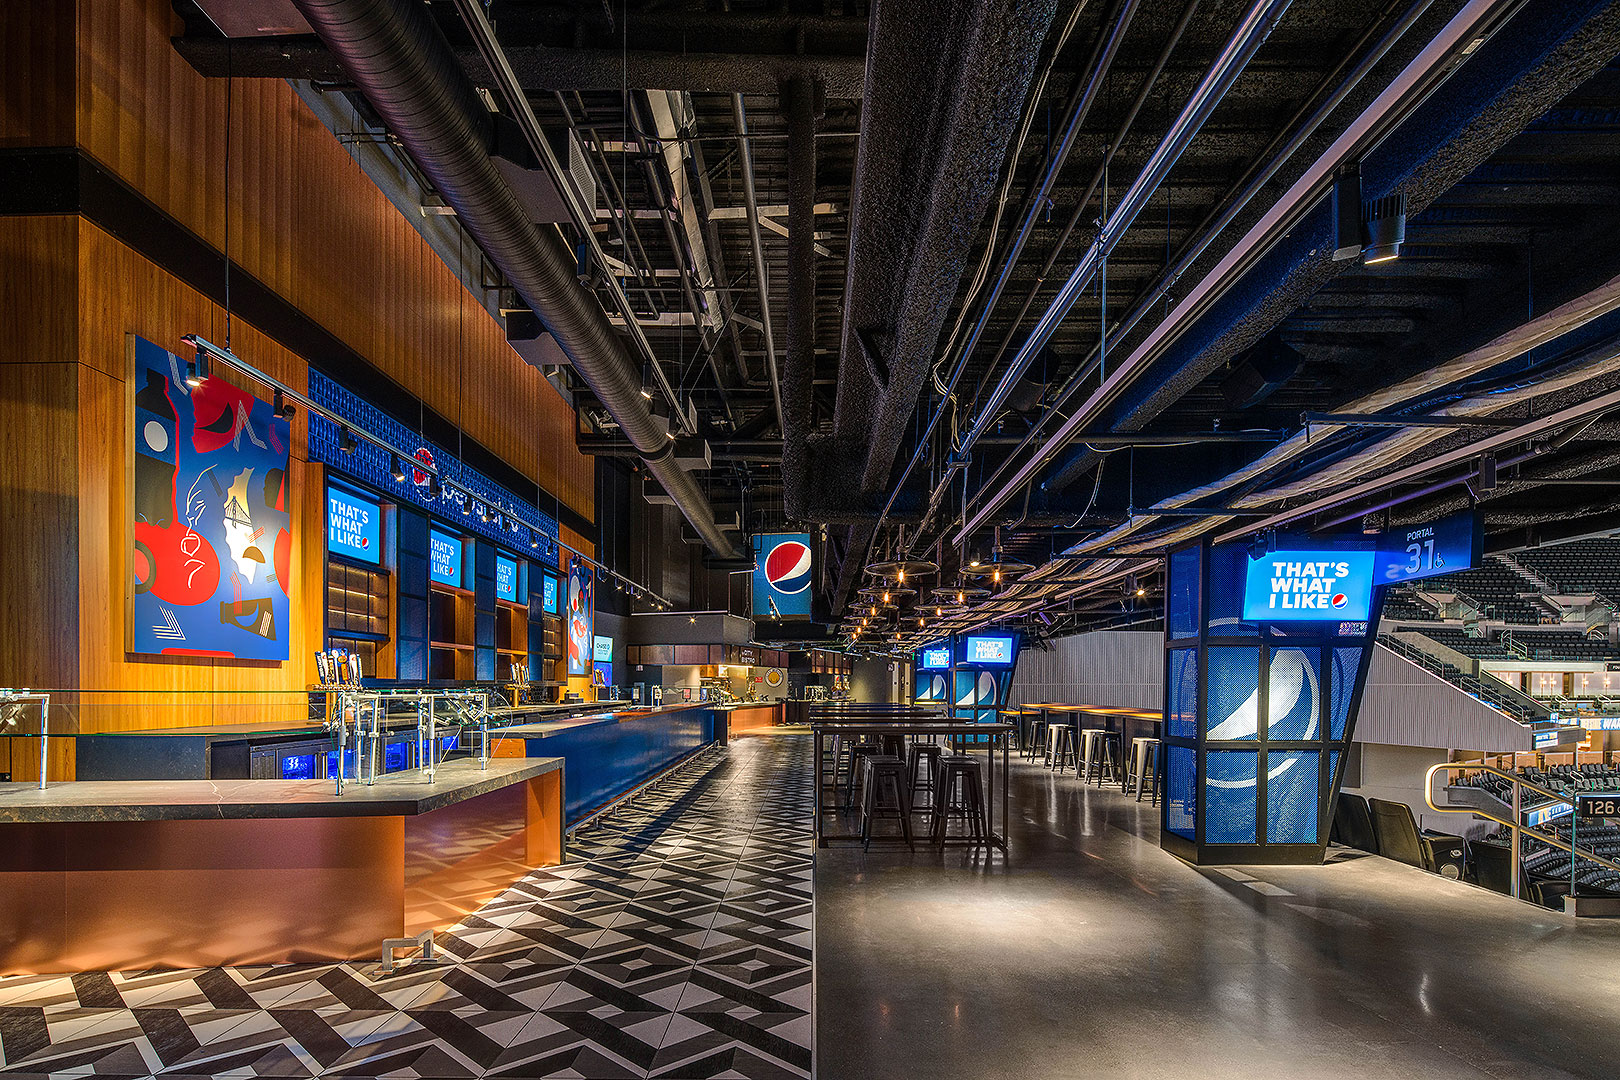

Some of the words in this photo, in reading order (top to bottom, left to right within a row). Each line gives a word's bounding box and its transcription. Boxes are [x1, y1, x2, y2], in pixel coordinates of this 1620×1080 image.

[330, 498, 369, 524] THAT'S
[330, 512, 363, 535] WHAT
[330, 527, 334, 541] I
[337, 530, 361, 549] LIKE
[1406, 527, 1434, 542] PORTAL
[431, 538, 455, 556] THAT'S
[1405, 539, 1434, 574] 31
[433, 562, 449, 576] LIKE
[1272, 562, 1349, 577] THAT'S
[1270, 578, 1336, 593] WHAT
[1269, 594, 1276, 609] I
[1282, 594, 1330, 609] LIKE
[1587, 801, 1615, 815] 126
